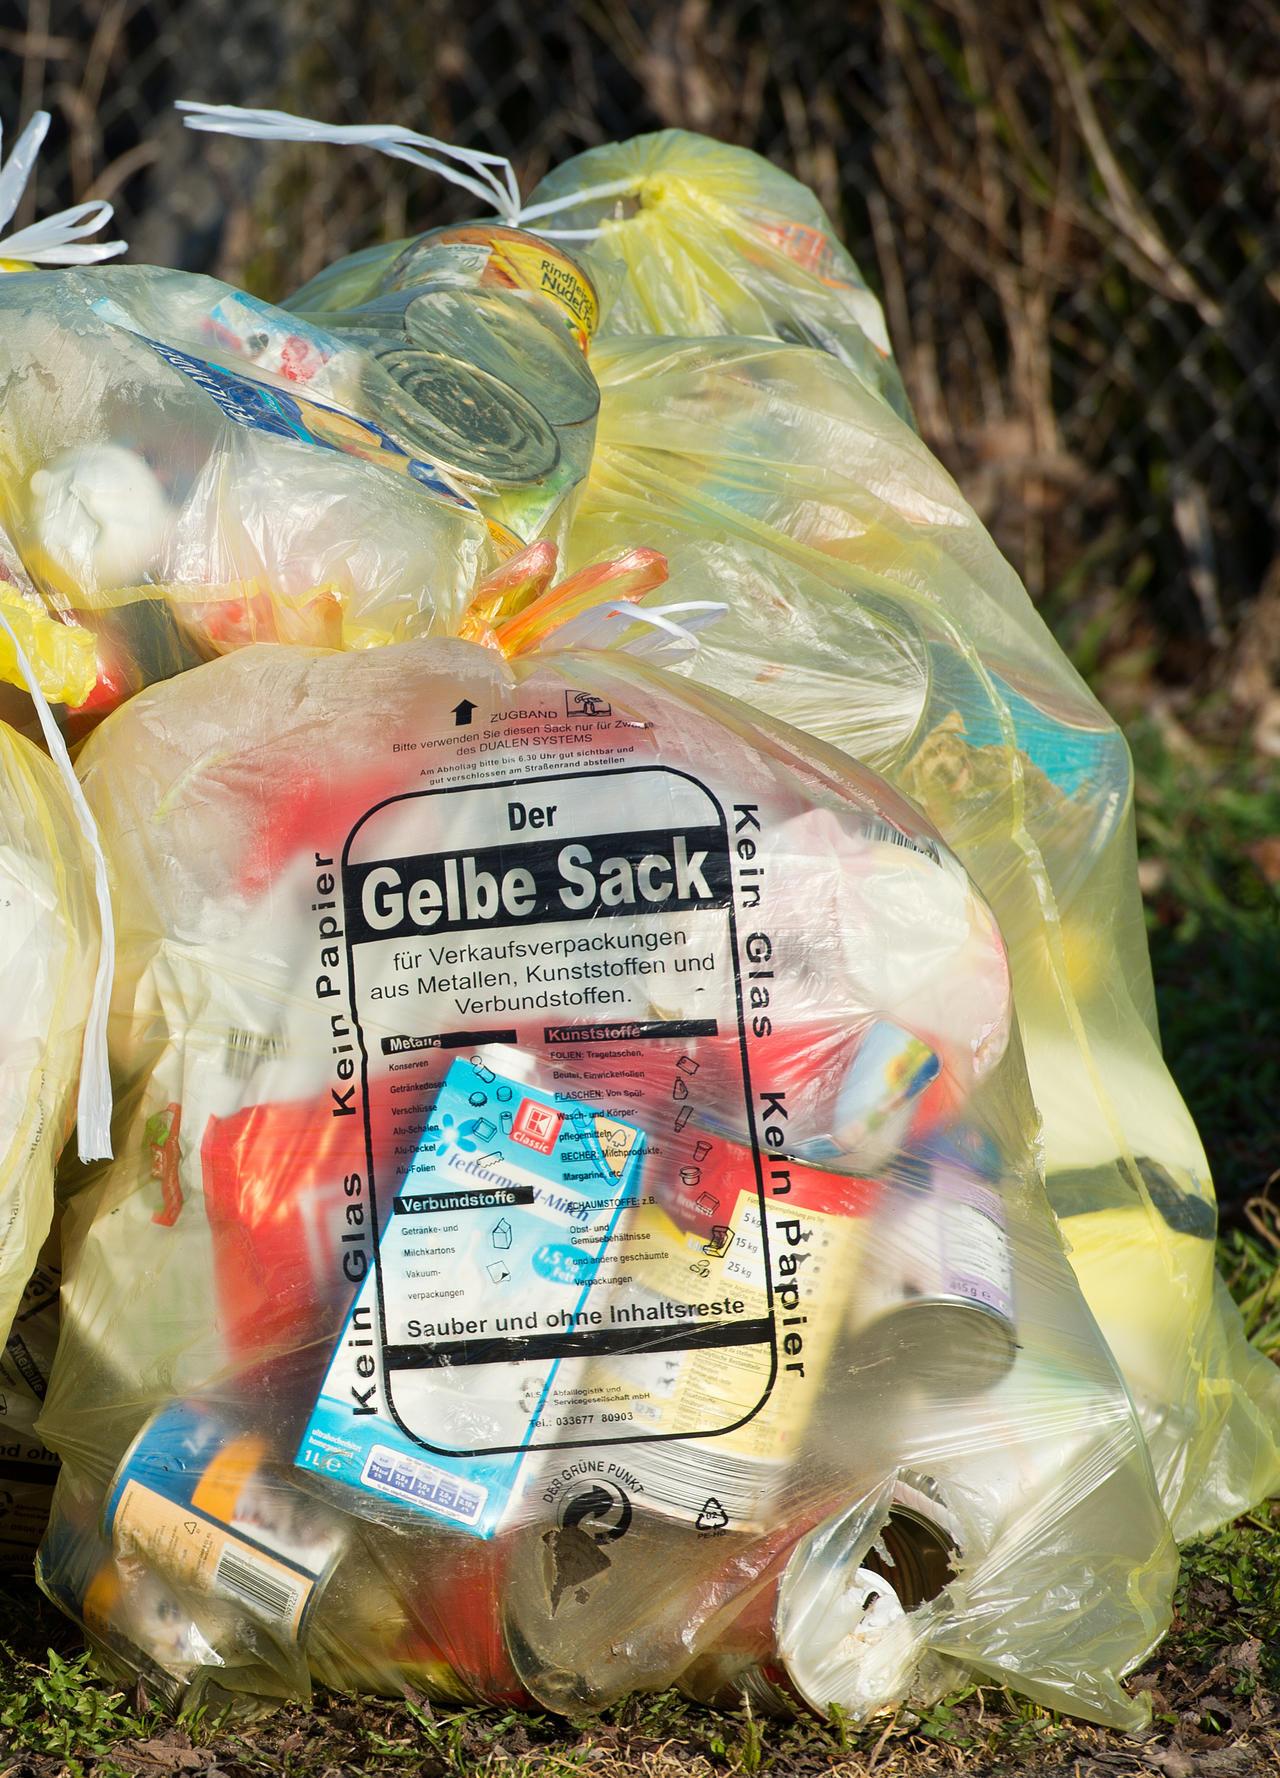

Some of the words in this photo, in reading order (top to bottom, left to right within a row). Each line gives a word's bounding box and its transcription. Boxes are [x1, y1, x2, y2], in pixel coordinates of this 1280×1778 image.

[490, 710, 558, 723] ZUGBAND
[392, 742, 417, 753] Bitte
[419, 733, 480, 749] verwenden
[483, 730, 501, 739] Sie
[503, 725, 540, 737] diesen
[543, 723, 572, 733] Sack
[575, 723, 594, 732] nur
[596, 720, 612, 730] für
[456, 746, 477, 756] des
[480, 738, 529, 752] DUALEN
[532, 733, 593, 746] SYSTEMS
[420, 768, 435, 777] Am
[479, 758, 499, 767] bitte
[502, 755, 516, 765] bis
[518, 753, 537, 762] 6.30
[539, 750, 556, 760] Uhr
[558, 751, 574, 760] gut
[577, 747, 614, 758] sichtbar
[616, 746, 635, 754] und
[429, 776, 444, 785] gut
[446, 769, 506, 782] verschlossen
[524, 760, 581, 773] Straßenrand
[583, 756, 625, 767] abstellen
[508, 801, 557, 831] Der
[733, 804, 761, 908] Kein
[360, 856, 537, 931] Gelbe
[557, 836, 714, 911] Sack
[312, 852, 344, 999] Papier
[393, 950, 422, 971] für
[429, 928, 687, 967] Verkaufsverpackungen
[370, 984, 410, 1001] aus
[418, 971, 518, 998] Metallen,
[526, 957, 665, 984] Kunststoffen
[673, 952, 716, 973] und
[743, 932, 773, 1039] Glas
[455, 987, 632, 1015] Verbundstoffen.
[548, 1025, 641, 1042] Kunststoffe
[331, 1014, 357, 1117] Kein
[389, 1060, 429, 1071] Konserven
[391, 1105, 438, 1116] Verschlüsse
[513, 1131, 551, 1154] Classic
[760, 1091, 792, 1195] Kein
[402, 1190, 516, 1213] Verbundstoffe
[342, 1172, 368, 1284] Glas
[594, 1223, 610, 1232] und
[743, 1211, 751, 1222] 5
[403, 1246, 456, 1257] Milchkartons
[736, 1237, 746, 1248] 15
[746, 1241, 758, 1254] kg
[406, 1269, 441, 1278] Vakuum-
[574, 1275, 633, 1287] Verpackungen
[727, 1261, 740, 1273] 25
[740, 1266, 752, 1279] kg
[408, 1288, 465, 1300] verpackungen
[775, 1220, 807, 1378] Papier
[407, 1317, 488, 1338] Sauber
[495, 1311, 538, 1333] und
[546, 1309, 602, 1328] ohne
[610, 1297, 745, 1323] Inhaltsreste
[349, 1307, 378, 1417] Kein
[556, 1415, 594, 1426] 033677
[601, 1412, 634, 1423] 80903
[542, 1478, 562, 1504] DER
[561, 1459, 605, 1482] GRÜNE
[607, 1463, 645, 1495] PUNKT
